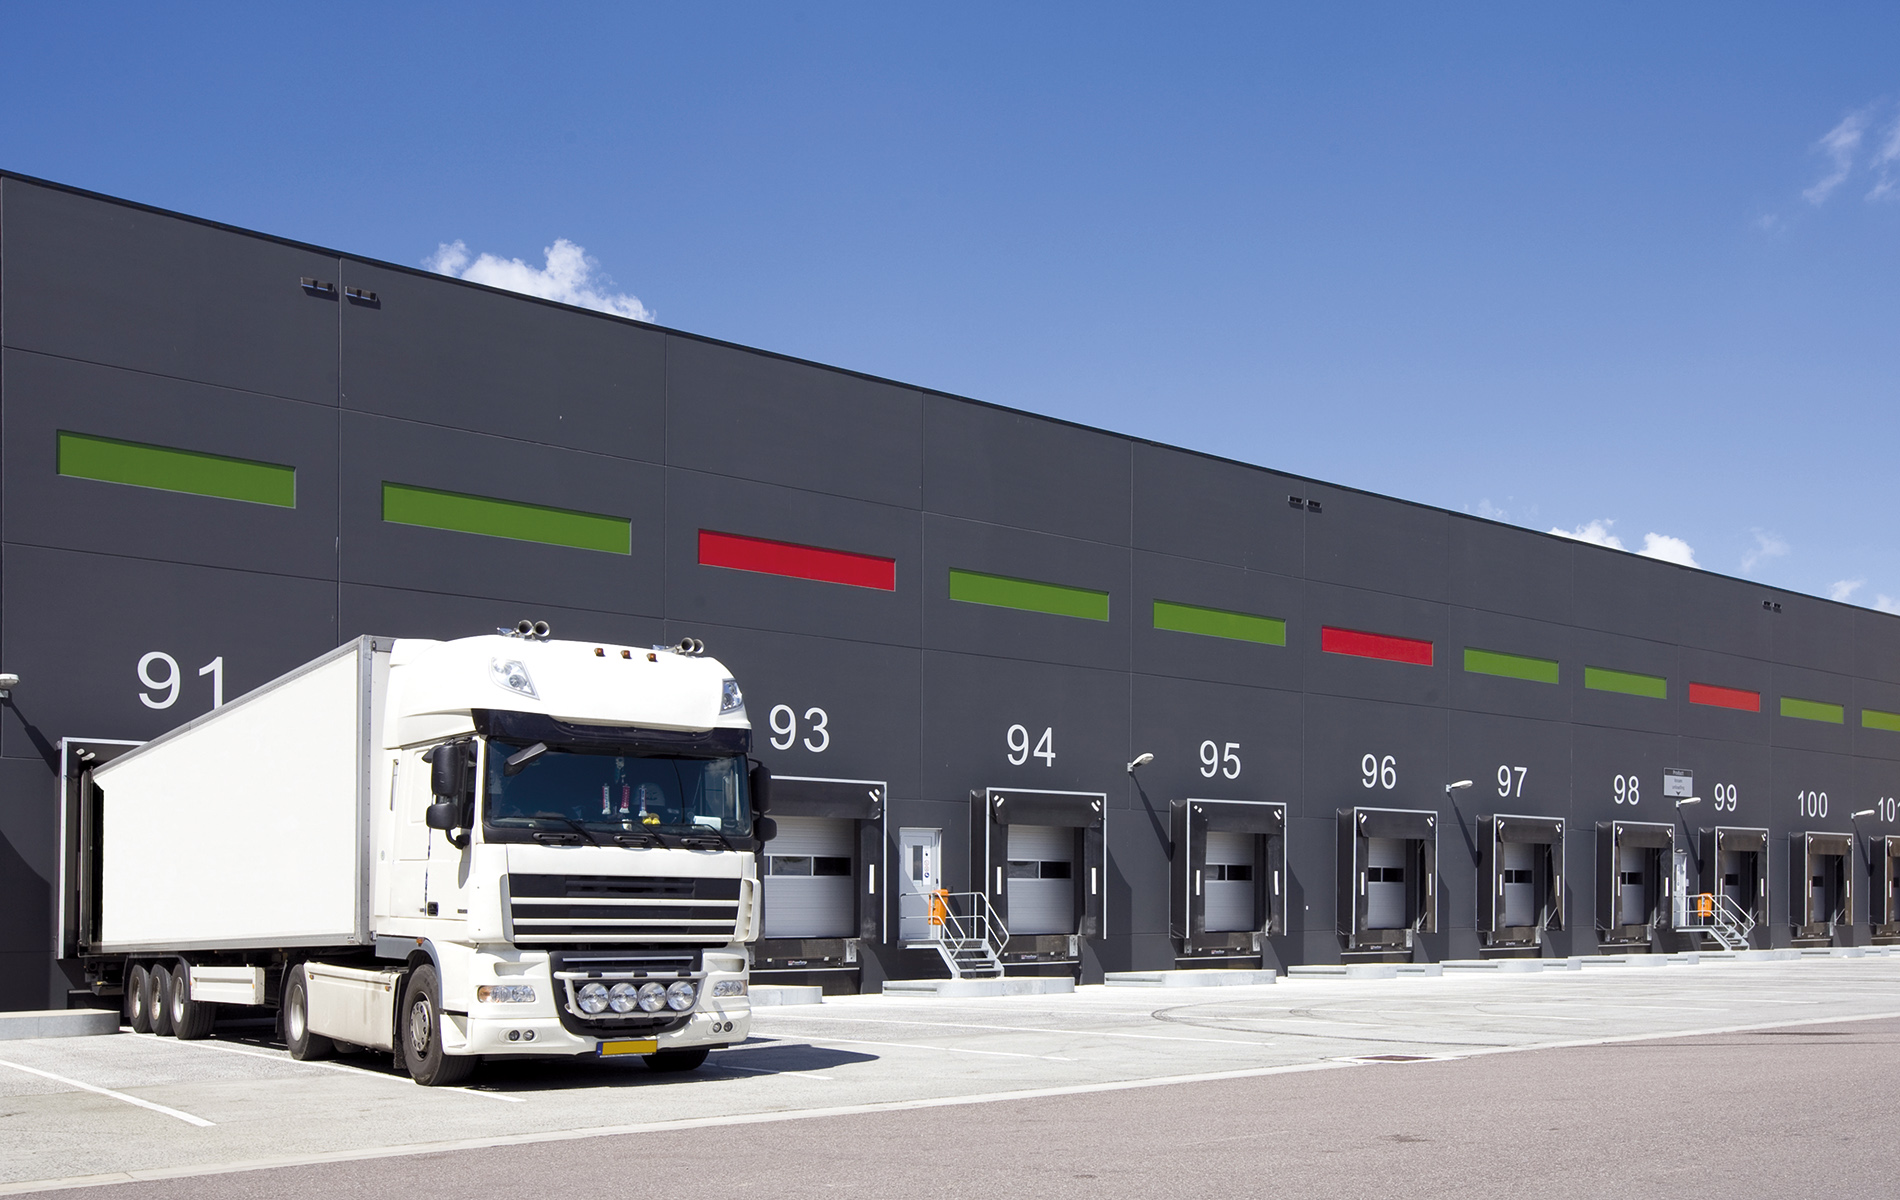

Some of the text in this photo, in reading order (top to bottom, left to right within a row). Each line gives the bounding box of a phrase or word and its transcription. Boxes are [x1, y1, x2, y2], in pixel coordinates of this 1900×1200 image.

[137, 651, 223, 709] 91
[769, 704, 830, 752] 93
[1006, 724, 1056, 767] 94
[1199, 740, 1241, 779] 95
[1361, 754, 1397, 789] 96
[1497, 765, 1528, 797] 97
[1613, 775, 1640, 805] 98
[1714, 783, 1737, 811] 99
[1797, 790, 1828, 818] 100
